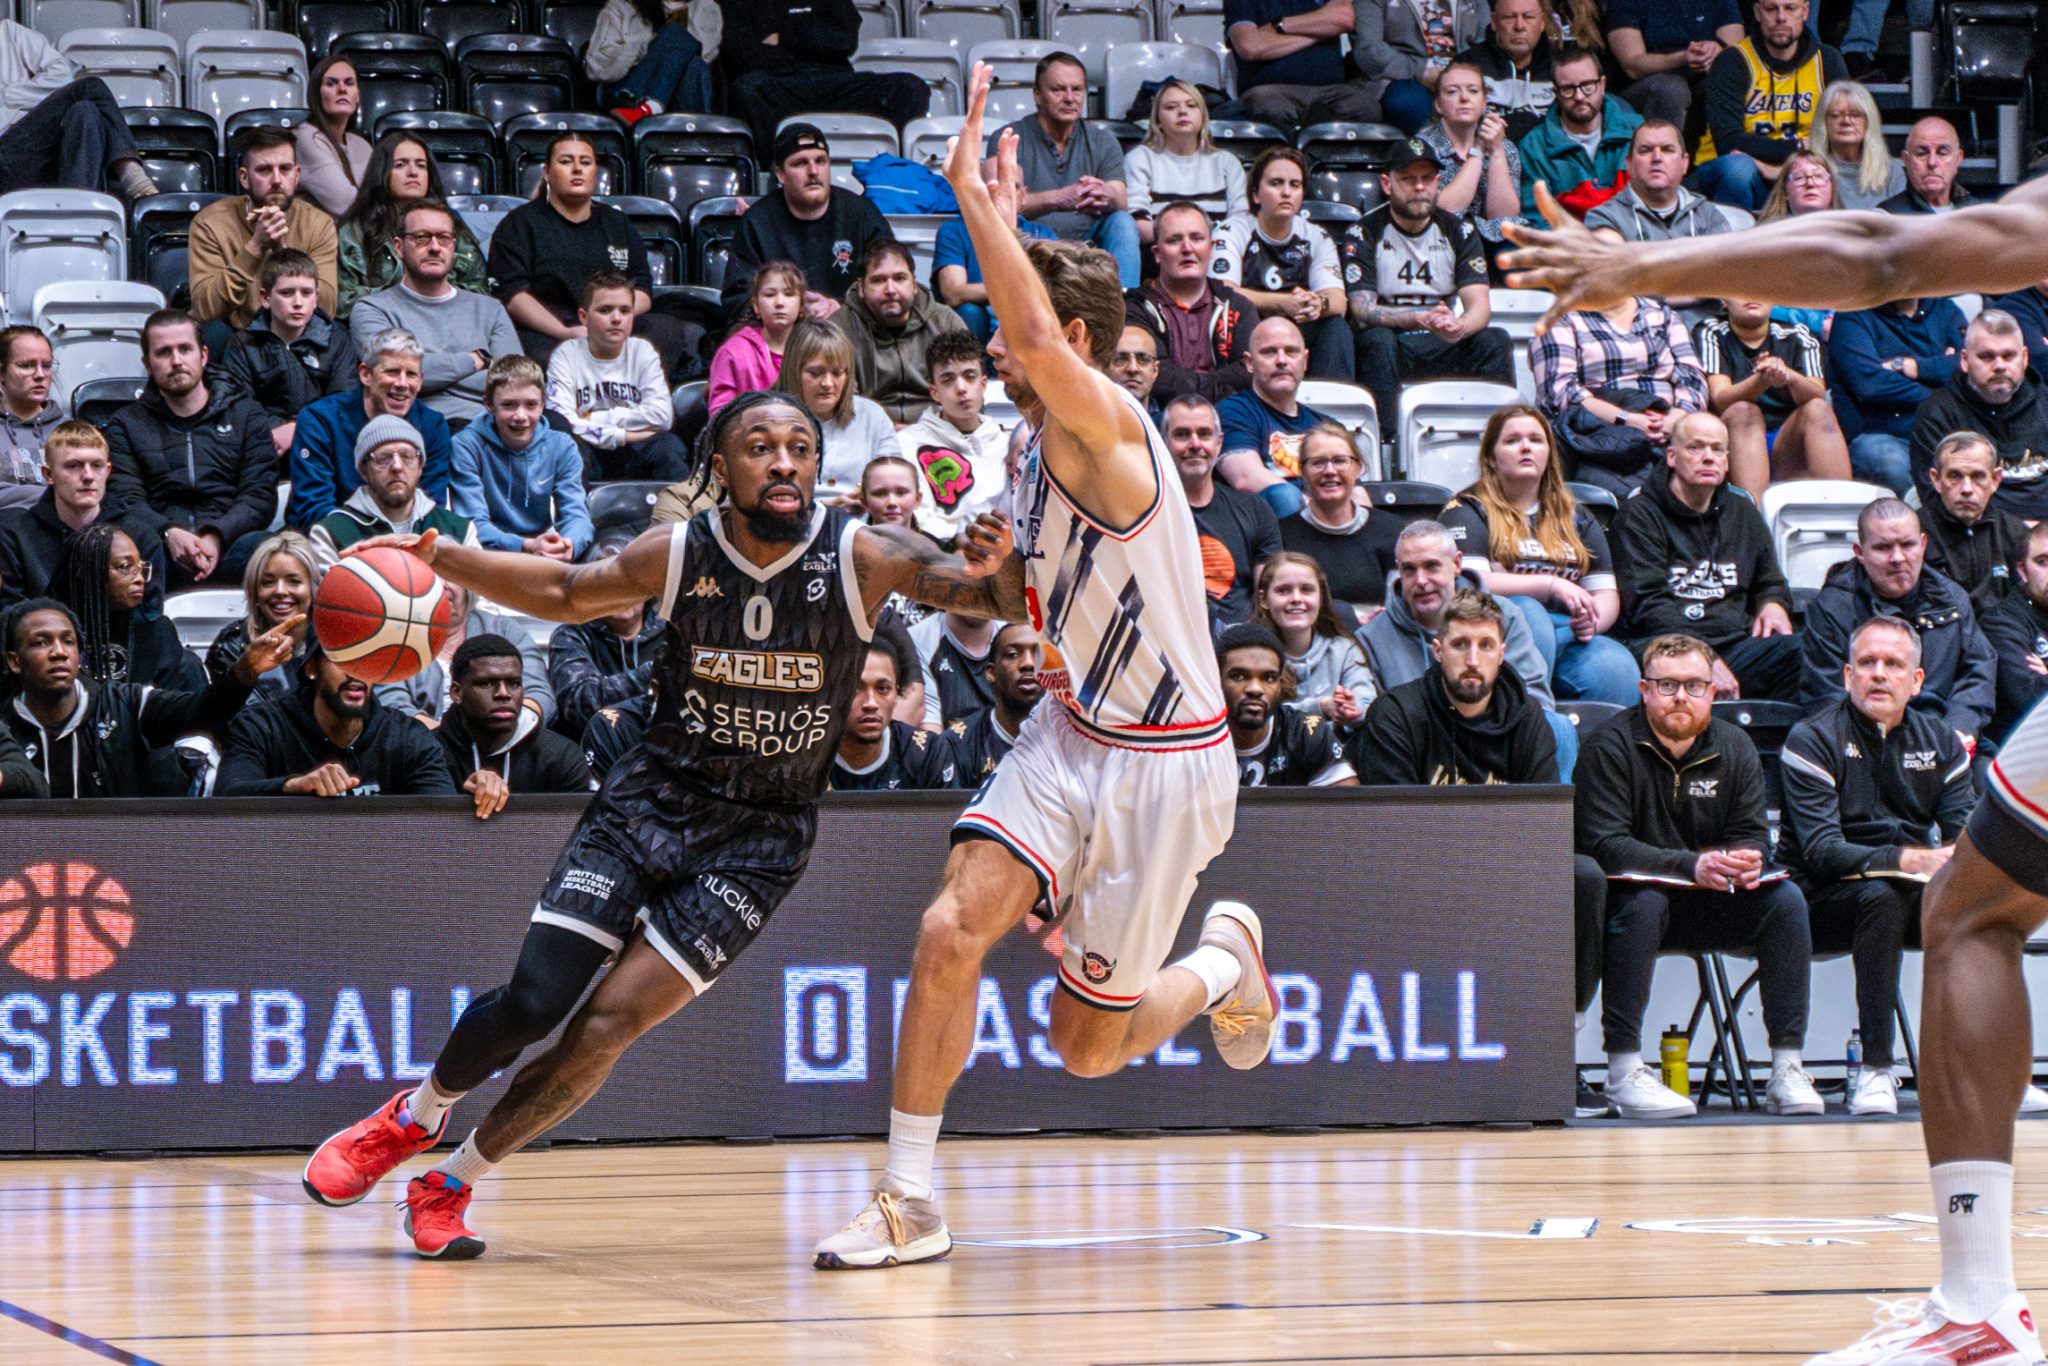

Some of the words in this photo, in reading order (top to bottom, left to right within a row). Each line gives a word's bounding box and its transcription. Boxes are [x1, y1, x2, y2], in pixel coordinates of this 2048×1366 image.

[1265, 266, 1283, 291] 6
[1397, 260, 1433, 285] 44
[575, 385, 590, 409] OS
[595, 381, 642, 405] ANGELE
[742, 595, 774, 641] 0
[691, 647, 823, 691] EAGLES
[713, 703, 832, 733] SERIÖS
[711, 728, 826, 757] GROUP
[560, 882, 610, 901] LEAGUE
[563, 876, 611, 894] BASKETBALL
[566, 869, 616, 888] BRITISH
[893, 971, 1507, 1071] ASBALL
